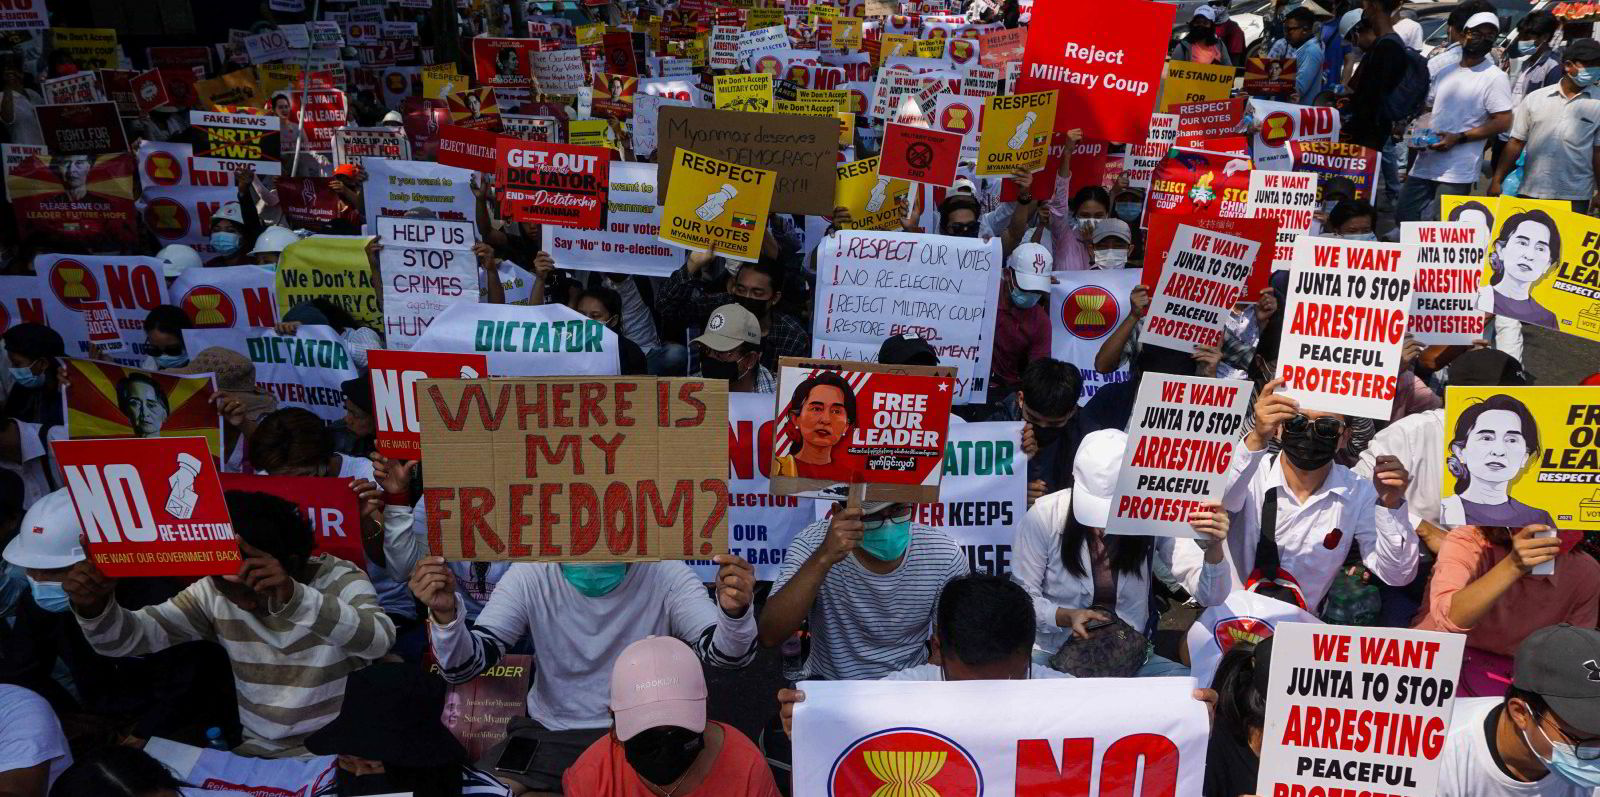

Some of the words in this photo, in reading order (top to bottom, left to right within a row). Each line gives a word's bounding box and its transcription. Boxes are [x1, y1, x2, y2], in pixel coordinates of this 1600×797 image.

[1064, 42, 1125, 65] Reject
[728, 76, 746, 84] Don't
[747, 76, 769, 84] Accept
[969, 69, 979, 78] WE
[979, 71, 995, 79] WANT
[1030, 62, 1098, 90] Military
[1103, 73, 1149, 97] Coup
[1169, 68, 1184, 79] WE
[1185, 71, 1218, 84] STAND
[1219, 74, 1233, 84] UP
[718, 85, 748, 93] MILITARY
[749, 84, 768, 92] COUP
[1186, 93, 1206, 102] FOR
[777, 103, 789, 111] We
[790, 103, 811, 112] Don't
[812, 104, 835, 112] Accept
[992, 92, 1053, 111] RESPECT
[1180, 102, 1232, 115] RESPECT
[203, 114, 230, 125] FAKE
[232, 116, 266, 127] NEWS
[1151, 117, 1173, 128] WANT
[1181, 116, 1200, 126] OUR
[1202, 114, 1231, 124] VOTES
[1300, 107, 1334, 137] NO
[207, 128, 264, 143] MRTV
[344, 136, 367, 145] WAKE
[369, 137, 380, 145] UP
[383, 138, 399, 146] AND
[668, 118, 751, 148] Myanmar
[754, 126, 816, 144] deserves
[1152, 129, 1161, 139] TO
[1162, 130, 1176, 139] STOP
[210, 145, 262, 159] MWD
[988, 152, 1013, 163] OUR
[1015, 147, 1044, 161] VOTES
[1300, 142, 1367, 157] RESPECT
[217, 161, 256, 172] TOXIC
[507, 148, 549, 169] GET
[552, 152, 599, 174] OUT
[682, 153, 766, 185] RESPECT
[1301, 152, 1325, 166] OUR
[1327, 156, 1367, 170] VOTES
[508, 168, 596, 190] DICTATOR
[611, 183, 638, 193] want
[642, 183, 653, 193] to
[1154, 180, 1186, 193] REJECT
[1265, 175, 1278, 188] WE
[1281, 176, 1310, 190] WANT
[40, 202, 69, 210] PLEASE
[506, 191, 525, 200] END
[534, 190, 597, 211] Dictatorship
[1152, 192, 1184, 203] MILITARY
[1156, 201, 1177, 209] COUP
[1254, 190, 1280, 205] JUNTA
[1282, 191, 1292, 205] TO
[1294, 193, 1314, 206] STOP
[529, 205, 580, 217] MYANMAR
[393, 224, 436, 242] HELP
[442, 227, 465, 244] US
[672, 216, 702, 233] OUR
[705, 224, 750, 243] VOTES
[1419, 228, 1436, 243] WE
[1440, 228, 1476, 244] WANT
[554, 237, 573, 250] Say
[575, 240, 599, 251] "No"
[601, 241, 612, 252] to
[614, 243, 673, 257] re-election.
[671, 229, 710, 245] MYANMAR
[713, 239, 748, 252] CITIZENS
[1192, 233, 1211, 251] WE
[1212, 238, 1249, 260] WANT
[403, 249, 455, 269] STOP
[847, 236, 918, 263] RESPECT
[920, 243, 948, 266] OUR
[956, 247, 992, 272] VOTES
[1314, 245, 1341, 268] WE
[1346, 247, 1402, 273] WANT
[1174, 251, 1208, 272] JUNTA
[1208, 258, 1221, 275] TO
[1222, 262, 1249, 281] STOP
[281, 269, 308, 288] We
[312, 269, 356, 288] Don't
[393, 274, 463, 297] CRIMES
[841, 269, 868, 286] NO
[1295, 272, 1342, 297] JUNTA
[1347, 275, 1367, 299] TO
[1371, 277, 1410, 302] STOP
[103, 265, 162, 311] NO
[1163, 272, 1240, 310] ARRESTING
[1553, 281, 1589, 296] RESPECT
[406, 301, 444, 312] against
[836, 294, 887, 315] REJECT
[892, 299, 947, 321] MILITARY
[1165, 302, 1219, 324] PEACEFUL
[1417, 298, 1474, 311] PEACEFUL
[832, 318, 884, 337] RESTORE
[1147, 315, 1222, 347] PROTESTERS
[1290, 302, 1405, 345] ARRESTING
[1407, 315, 1484, 334] PROTESTERS
[1582, 320, 1597, 329] VOTE
[475, 319, 604, 353] DICTATOR
[246, 336, 349, 370] DICTATOR
[1300, 343, 1384, 368] PEACEFUL
[1282, 364, 1398, 402] PROTESTERS
[873, 391, 928, 412] FREE
[1161, 381, 1186, 404] WE
[1190, 383, 1238, 408] WANT
[427, 382, 638, 431] WHERE
[656, 381, 707, 428] IS
[873, 410, 924, 429] OUR
[1140, 406, 1184, 430] JUNTA
[1186, 410, 1205, 432] TO
[1205, 412, 1242, 435] STOP
[852, 428, 939, 448] LEADER
[525, 432, 627, 478] MY
[1131, 435, 1233, 475] ARRESTING
[1137, 475, 1210, 495] PEACEFUL
[1539, 473, 1589, 483] RESPECT
[64, 464, 158, 543] NO
[423, 478, 728, 558] FREEDOM?
[948, 501, 1013, 527] KEEPS
[157, 523, 235, 542] RE-ELECTION
[733, 524, 768, 541] OUR
[95, 553, 108, 564] WE
[109, 553, 135, 564] WANT
[136, 552, 156, 563] OUR
[156, 551, 215, 563] GOVERNMENT
[216, 550, 241, 562] BACK
[1312, 634, 1350, 663] WE
[1360, 637, 1440, 670] WANT
[1287, 667, 1353, 699] JUNTA
[1362, 672, 1389, 702] TO
[1396, 675, 1454, 707] STOP
[1281, 705, 1445, 761] ARRESTING
[1297, 757, 1417, 788] PEACEFUL
